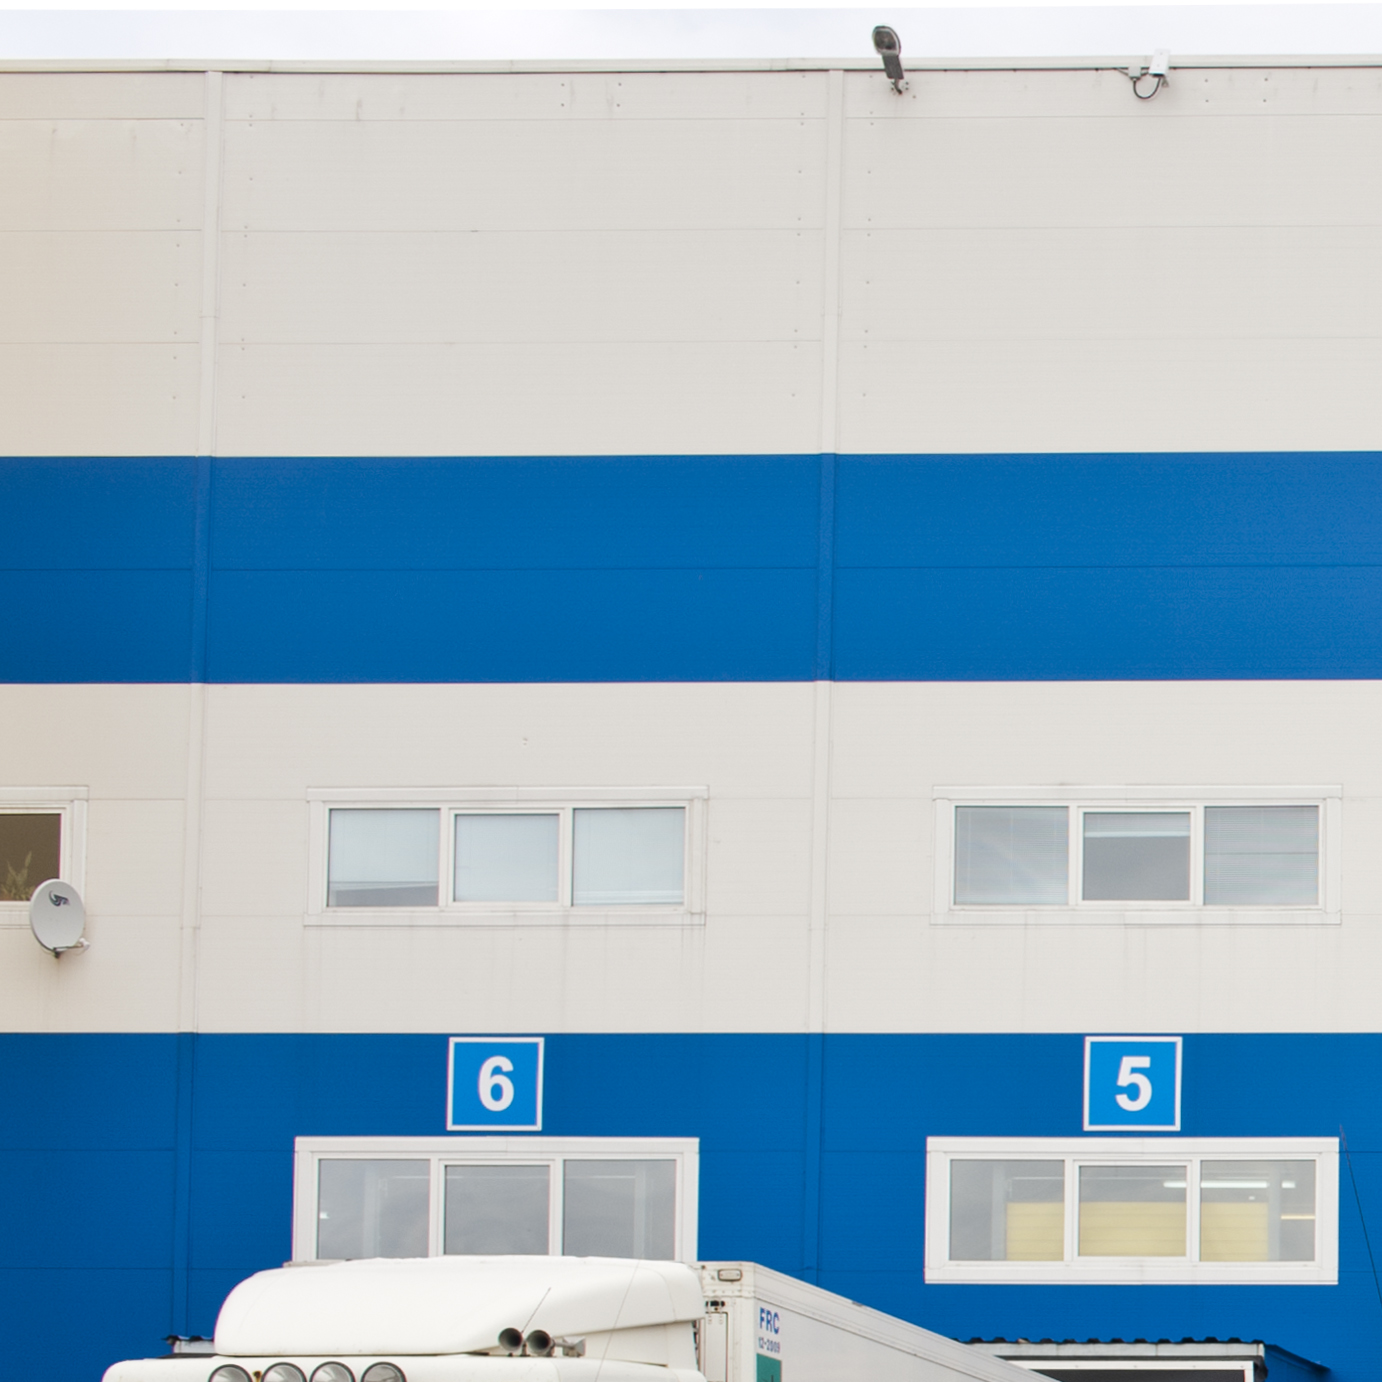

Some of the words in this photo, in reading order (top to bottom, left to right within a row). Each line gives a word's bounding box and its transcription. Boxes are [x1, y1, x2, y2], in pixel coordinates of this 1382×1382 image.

[478, 1055, 514, 1112] 6
[1115, 1055, 1152, 1112] 5
[759, 1306, 780, 1335] FRC
